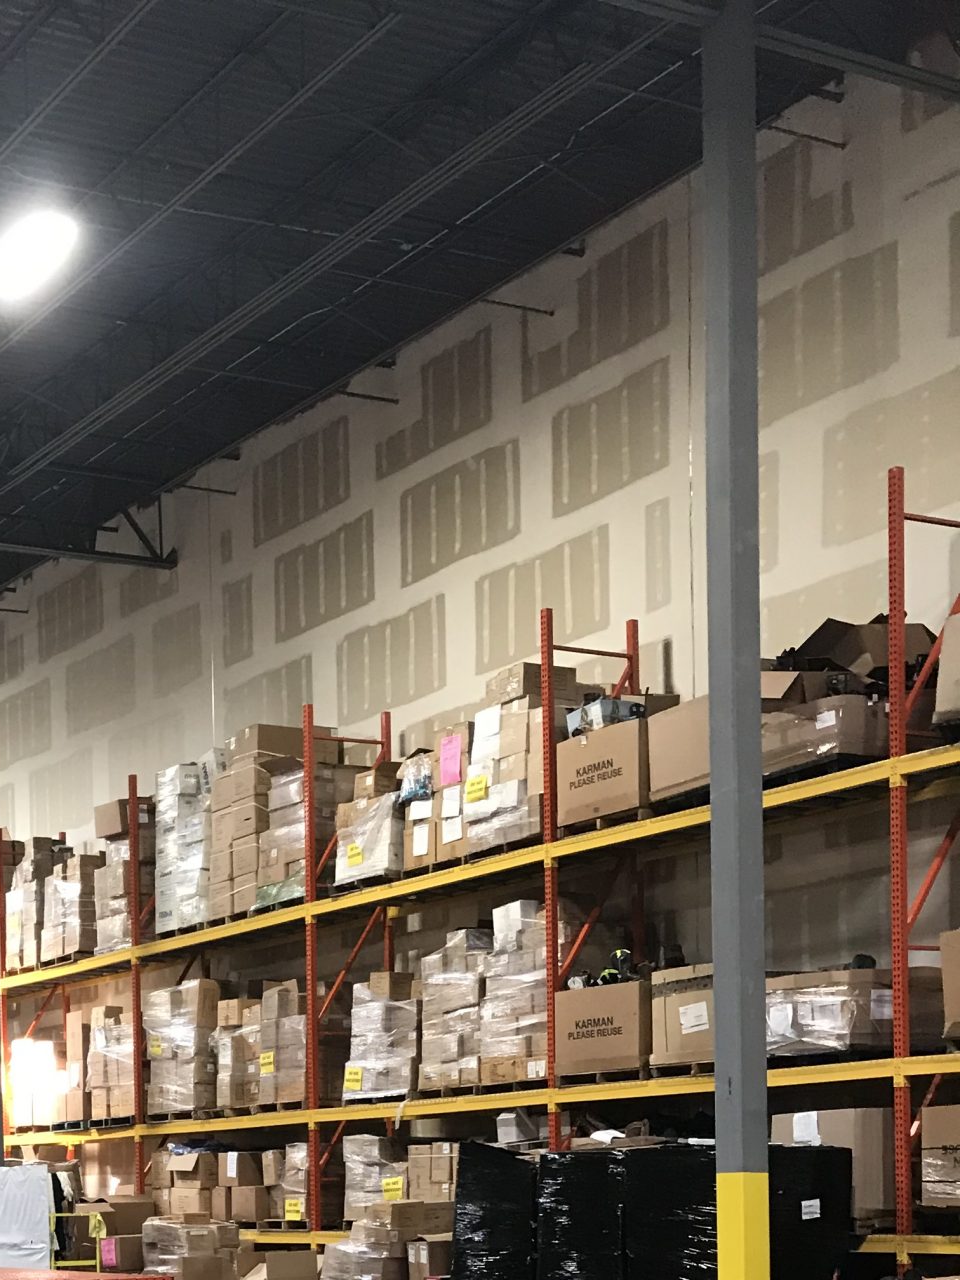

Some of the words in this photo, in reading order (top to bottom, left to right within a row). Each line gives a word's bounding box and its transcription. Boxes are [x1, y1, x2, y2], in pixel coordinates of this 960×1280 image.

[576, 758, 614, 778] KARMAN
[569, 775, 596, 791] PLEASE
[575, 1016, 614, 1030] KARMAN
[568, 1029, 596, 1041] PLEASE
[596, 1026, 623, 1038] REUSE
